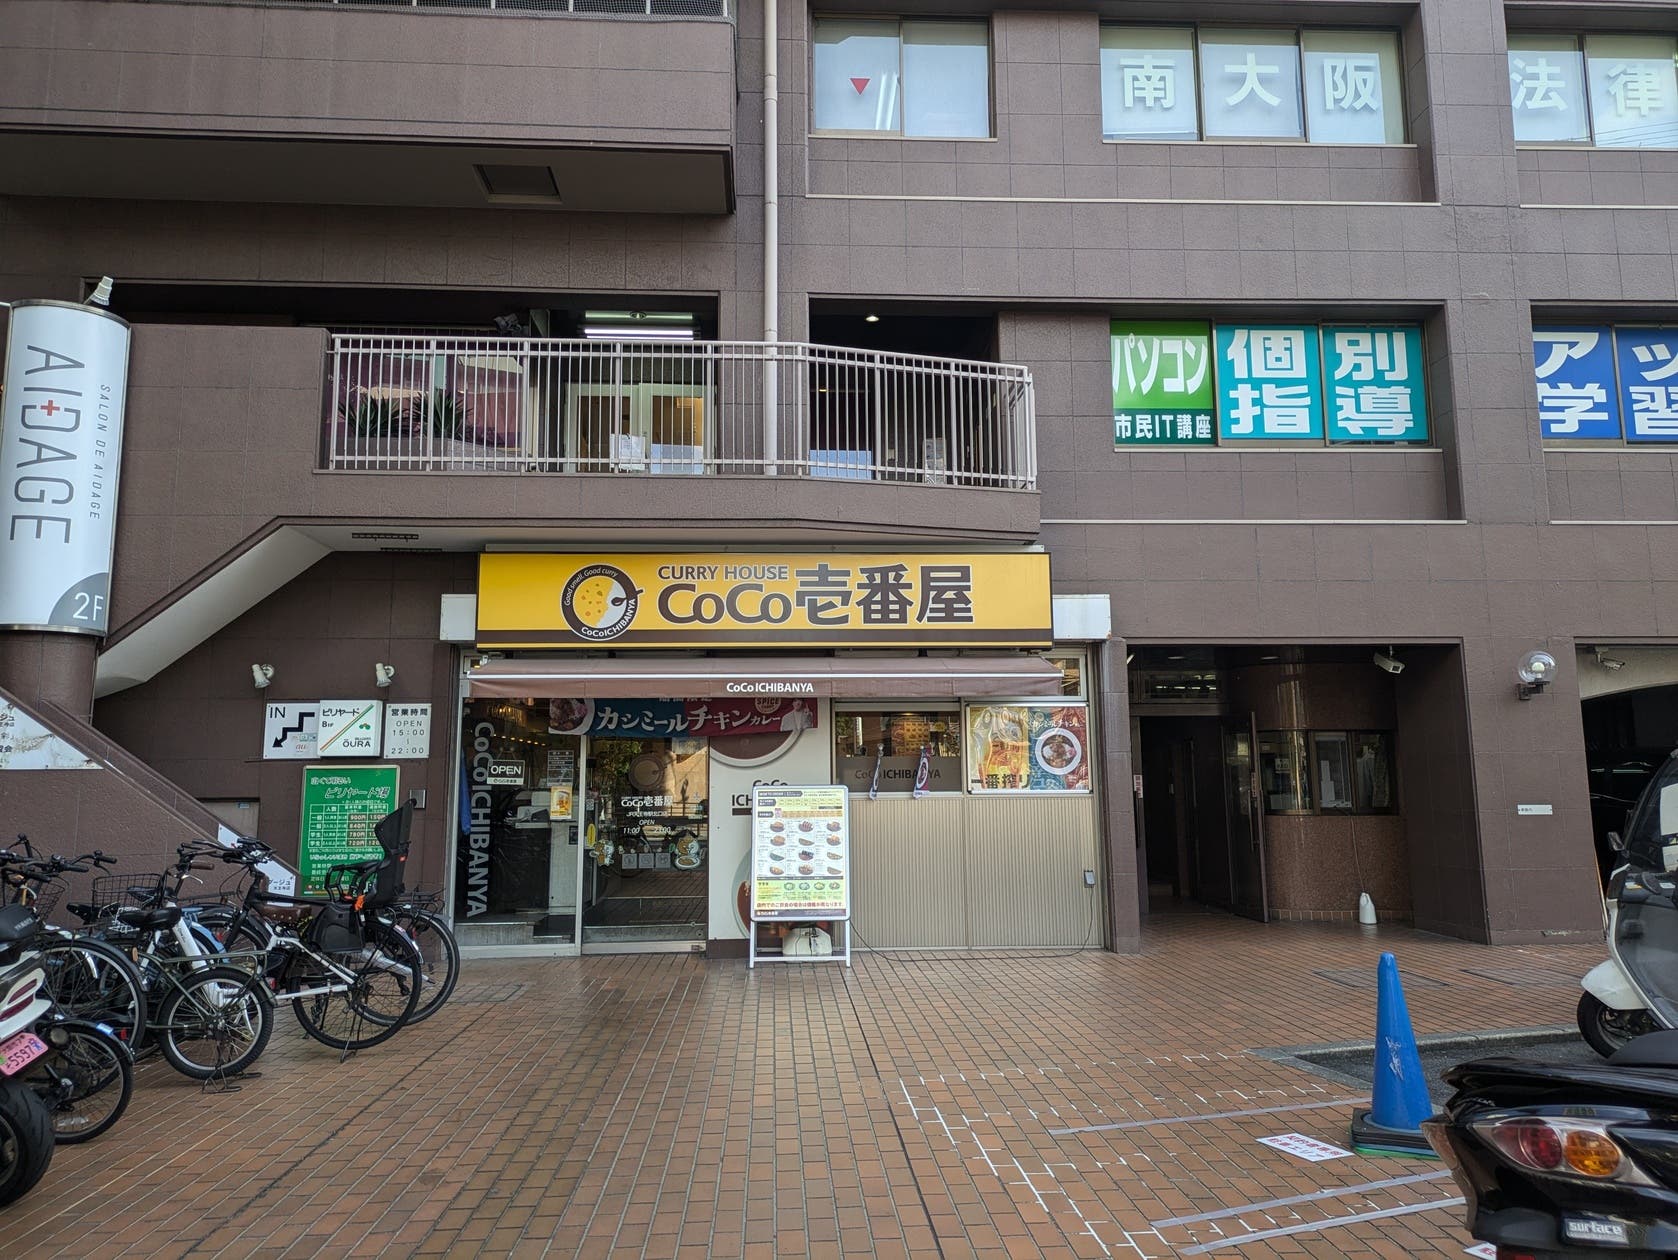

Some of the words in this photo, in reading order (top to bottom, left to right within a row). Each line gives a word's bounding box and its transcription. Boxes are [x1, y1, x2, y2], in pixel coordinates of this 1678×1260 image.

[1119, 54, 1380, 112] 南大阪
[1112, 333, 1208, 395] パソコン
[96, 384, 112, 432] SALON
[1114, 414, 1212, 439] 市民IT講座
[95, 440, 106, 456] DE
[88, 464, 104, 519] AIDAGE
[658, 566, 718, 580] CURRY
[724, 566, 788, 580] HOUSE
[563, 588, 573, 606] Good
[584, 568, 601, 577] Good
[601, 568, 619, 578] curry
[658, 563, 974, 625] CoCo壱番屋
[73, 592, 104, 621] 2F
[269, 707, 286, 718] IN
[322, 707, 360, 717] ビリヤード
[391, 708, 428, 717] 営業時間
[490, 765, 522, 775] OPEN
[883, 769, 941, 779] ICHIBAYA
